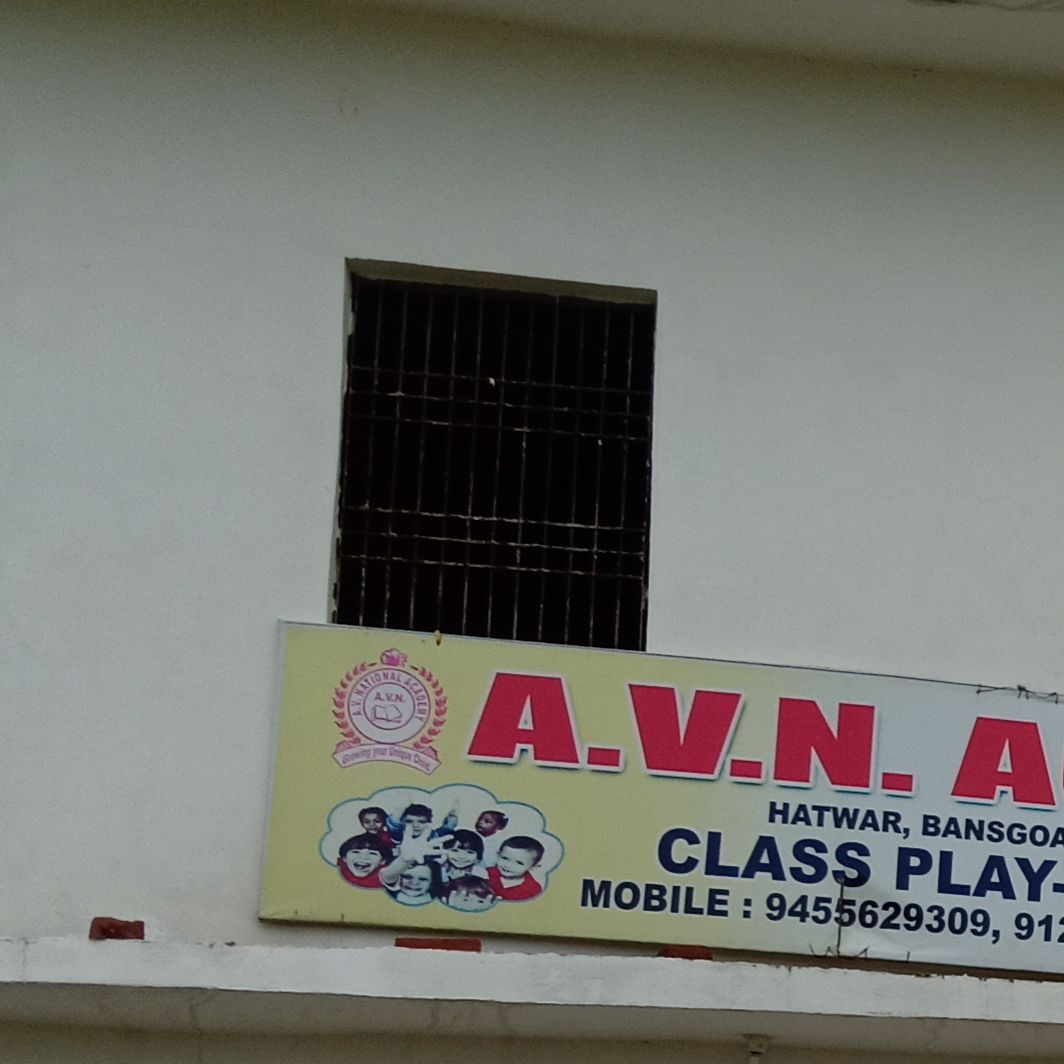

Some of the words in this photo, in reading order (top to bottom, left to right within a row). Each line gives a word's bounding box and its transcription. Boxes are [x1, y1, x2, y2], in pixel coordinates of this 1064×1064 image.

[354, 671, 402, 697] NATIONAL
[403, 677, 428, 722] ACADEMY
[467, 672, 914, 793] A.V.N.
[768, 801, 911, 839] HATWAR,
[657, 828, 872, 888] CLASS
[580, 878, 731, 918] MOBILE
[765, 892, 1001, 945] 9455629309,
